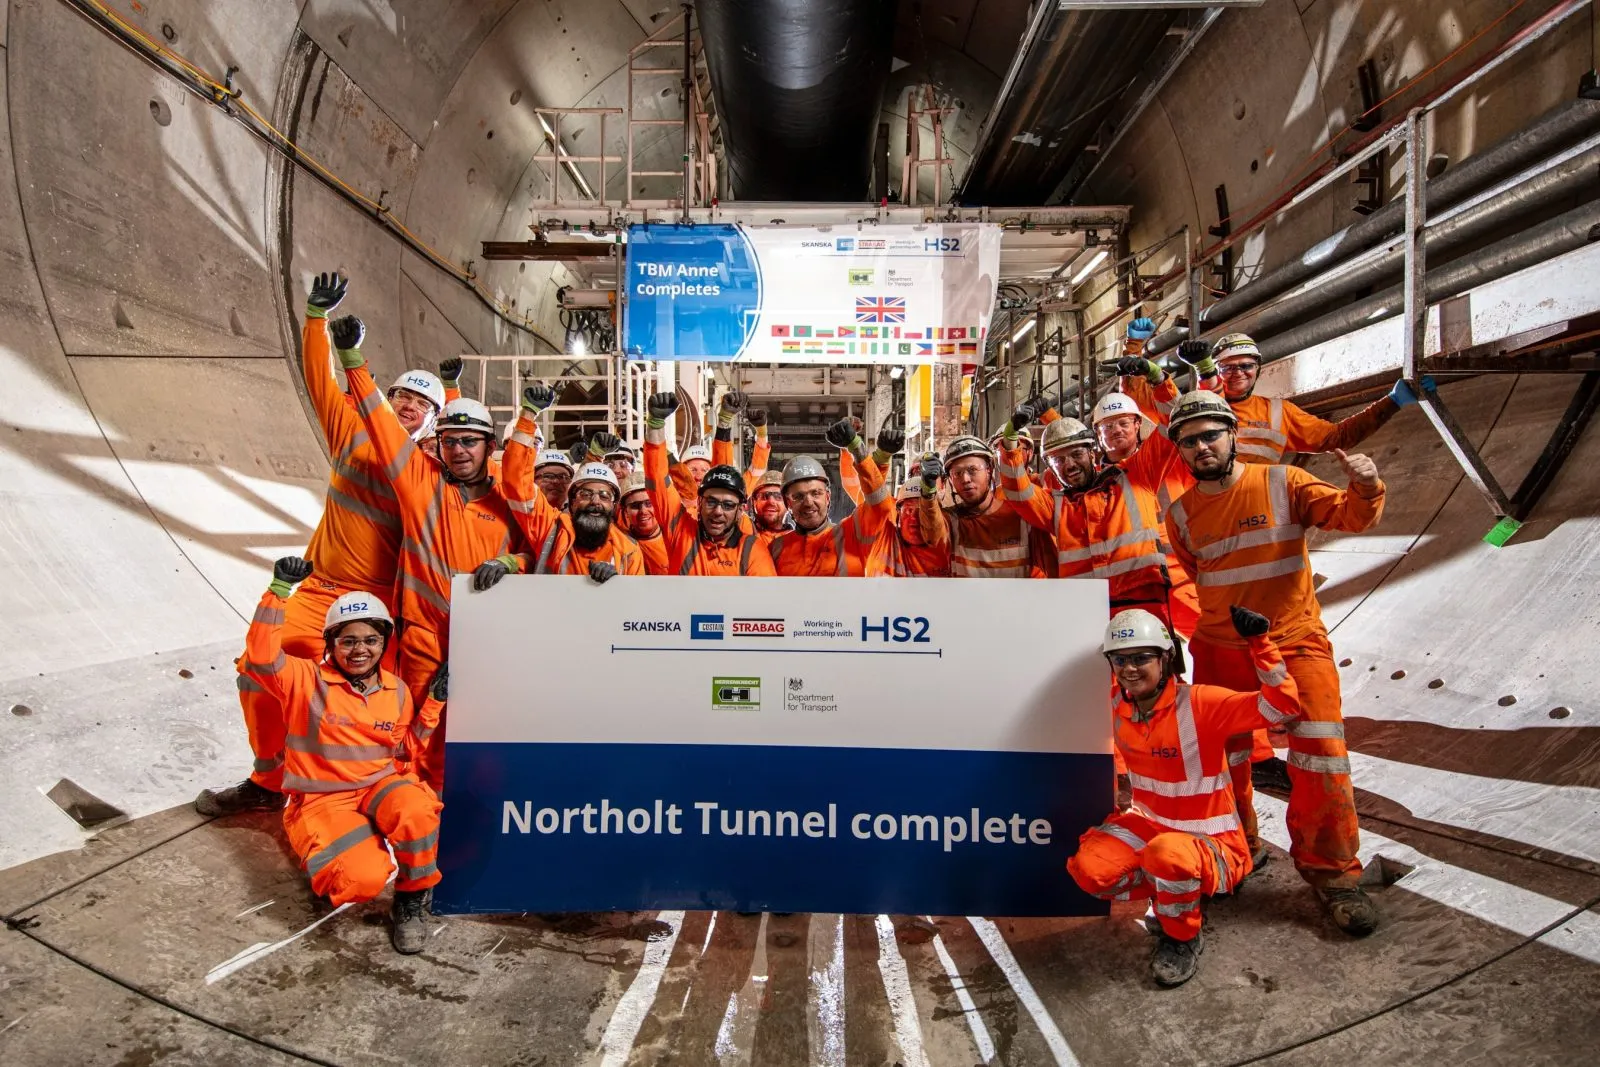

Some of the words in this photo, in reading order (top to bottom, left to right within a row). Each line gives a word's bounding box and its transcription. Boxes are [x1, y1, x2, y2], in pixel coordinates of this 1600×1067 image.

[924, 238, 960, 251] HS2
[637, 262, 672, 277] TBM
[677, 263, 718, 277] Anne
[637, 281, 720, 300] completes
[407, 376, 430, 388] HS2
[1103, 402, 1123, 413] HS2
[586, 468, 608, 476] HS2
[712, 472, 732, 480] HS2
[477, 511, 496, 521] HS2
[1239, 514, 1267, 528] HS2
[340, 602, 368, 614] HS2
[623, 621, 682, 632] SKANSKA
[702, 623, 725, 631] COSTAIN
[732, 622, 785, 633] STRABAG
[803, 620, 834, 628] Working
[861, 616, 931, 643] HS2
[793, 629, 836, 638] partnership
[1111, 629, 1135, 639] HS2
[788, 693, 834, 702] Department
[788, 703, 798, 711] for
[800, 703, 838, 712] Transport
[1151, 747, 1178, 759] HS2
[501, 798, 682, 835] Northolt
[694, 802, 837, 838] Tunnel
[851, 808, 1053, 852] complete
